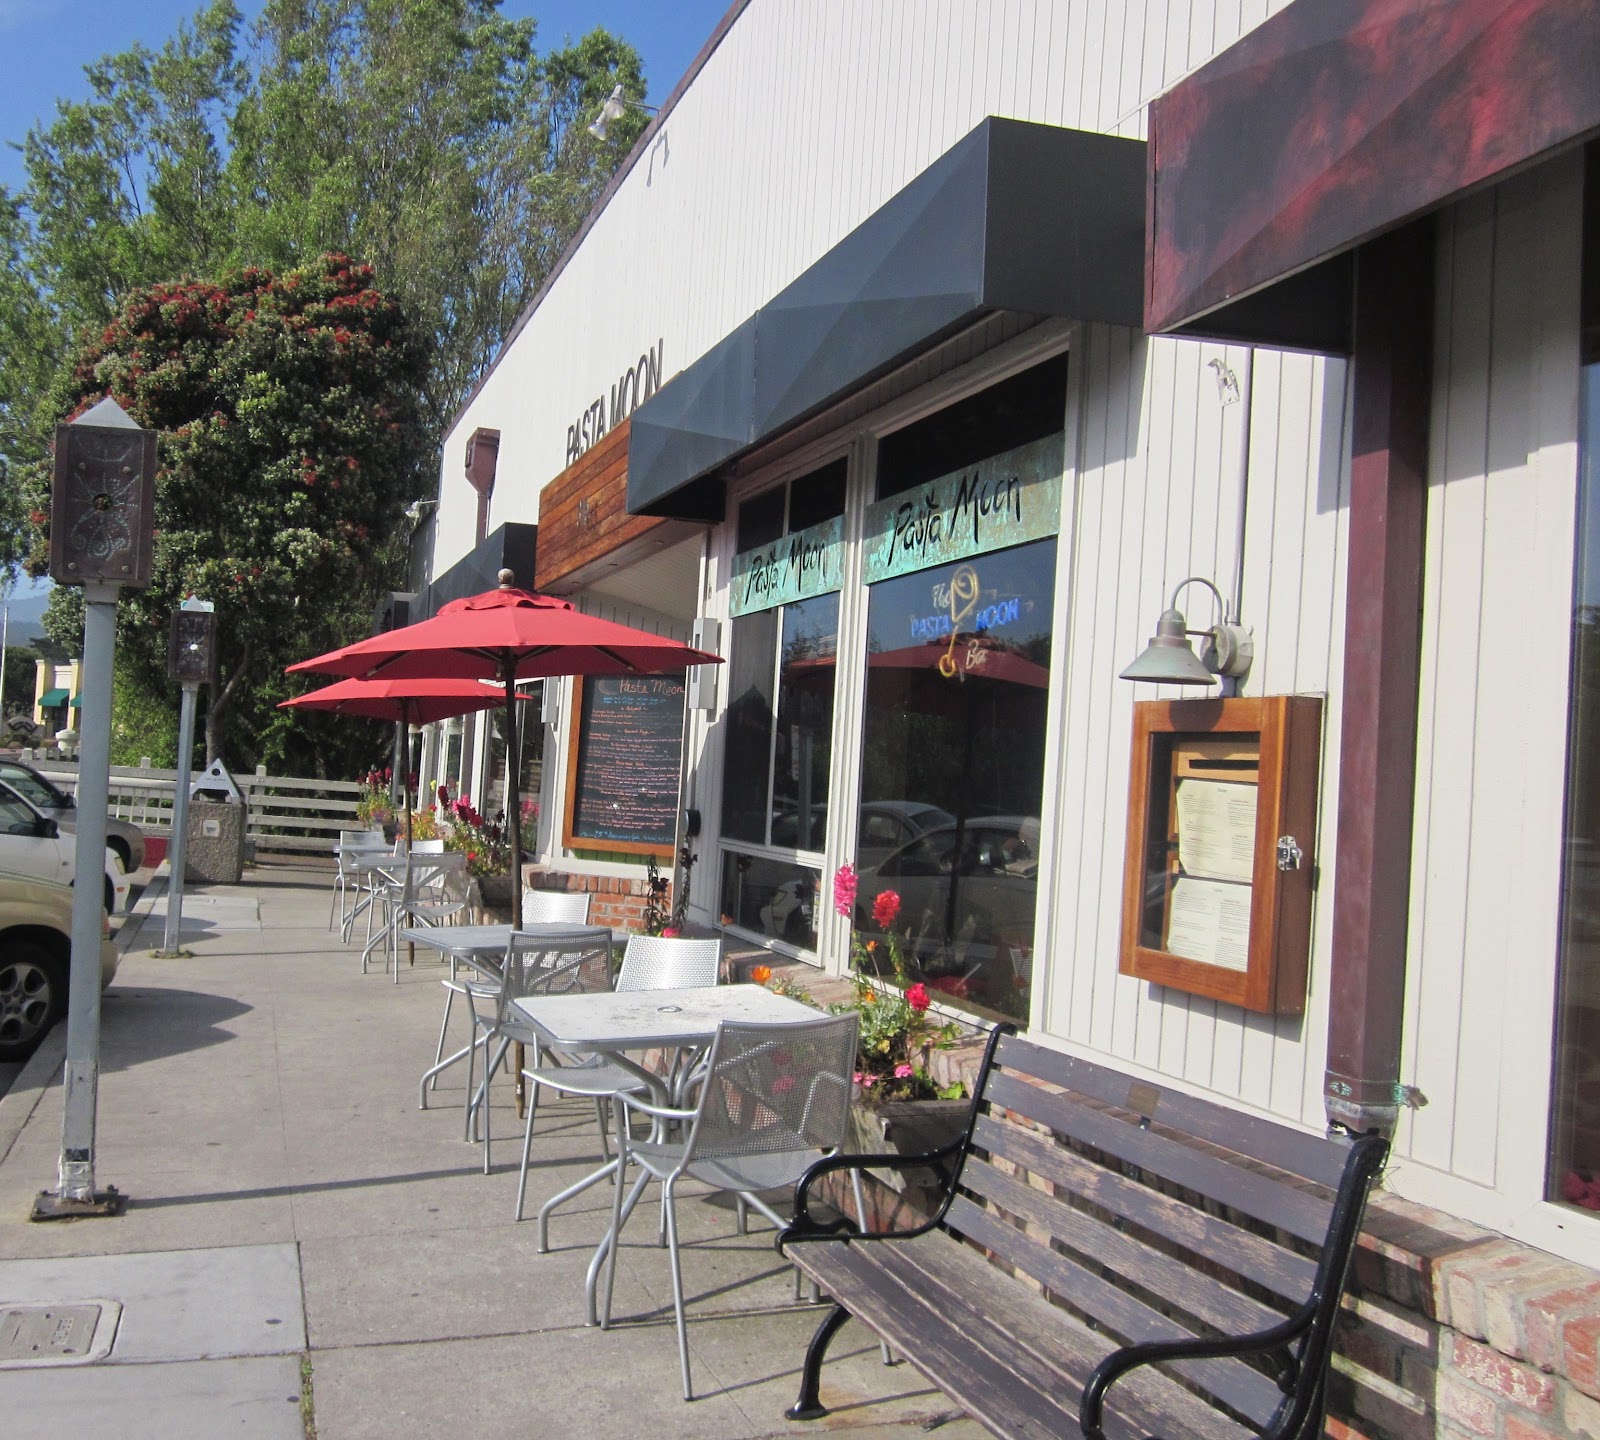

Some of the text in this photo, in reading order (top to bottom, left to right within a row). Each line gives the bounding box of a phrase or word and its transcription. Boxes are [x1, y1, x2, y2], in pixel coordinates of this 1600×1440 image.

[566, 337, 664, 469] PASTA MOON
[887, 470, 1021, 567] Pasta Moon
[744, 535, 827, 605] Pasta Moon
[910, 598, 1020, 638] PASTA MOON
[619, 676, 686, 697] Pasta Moon
